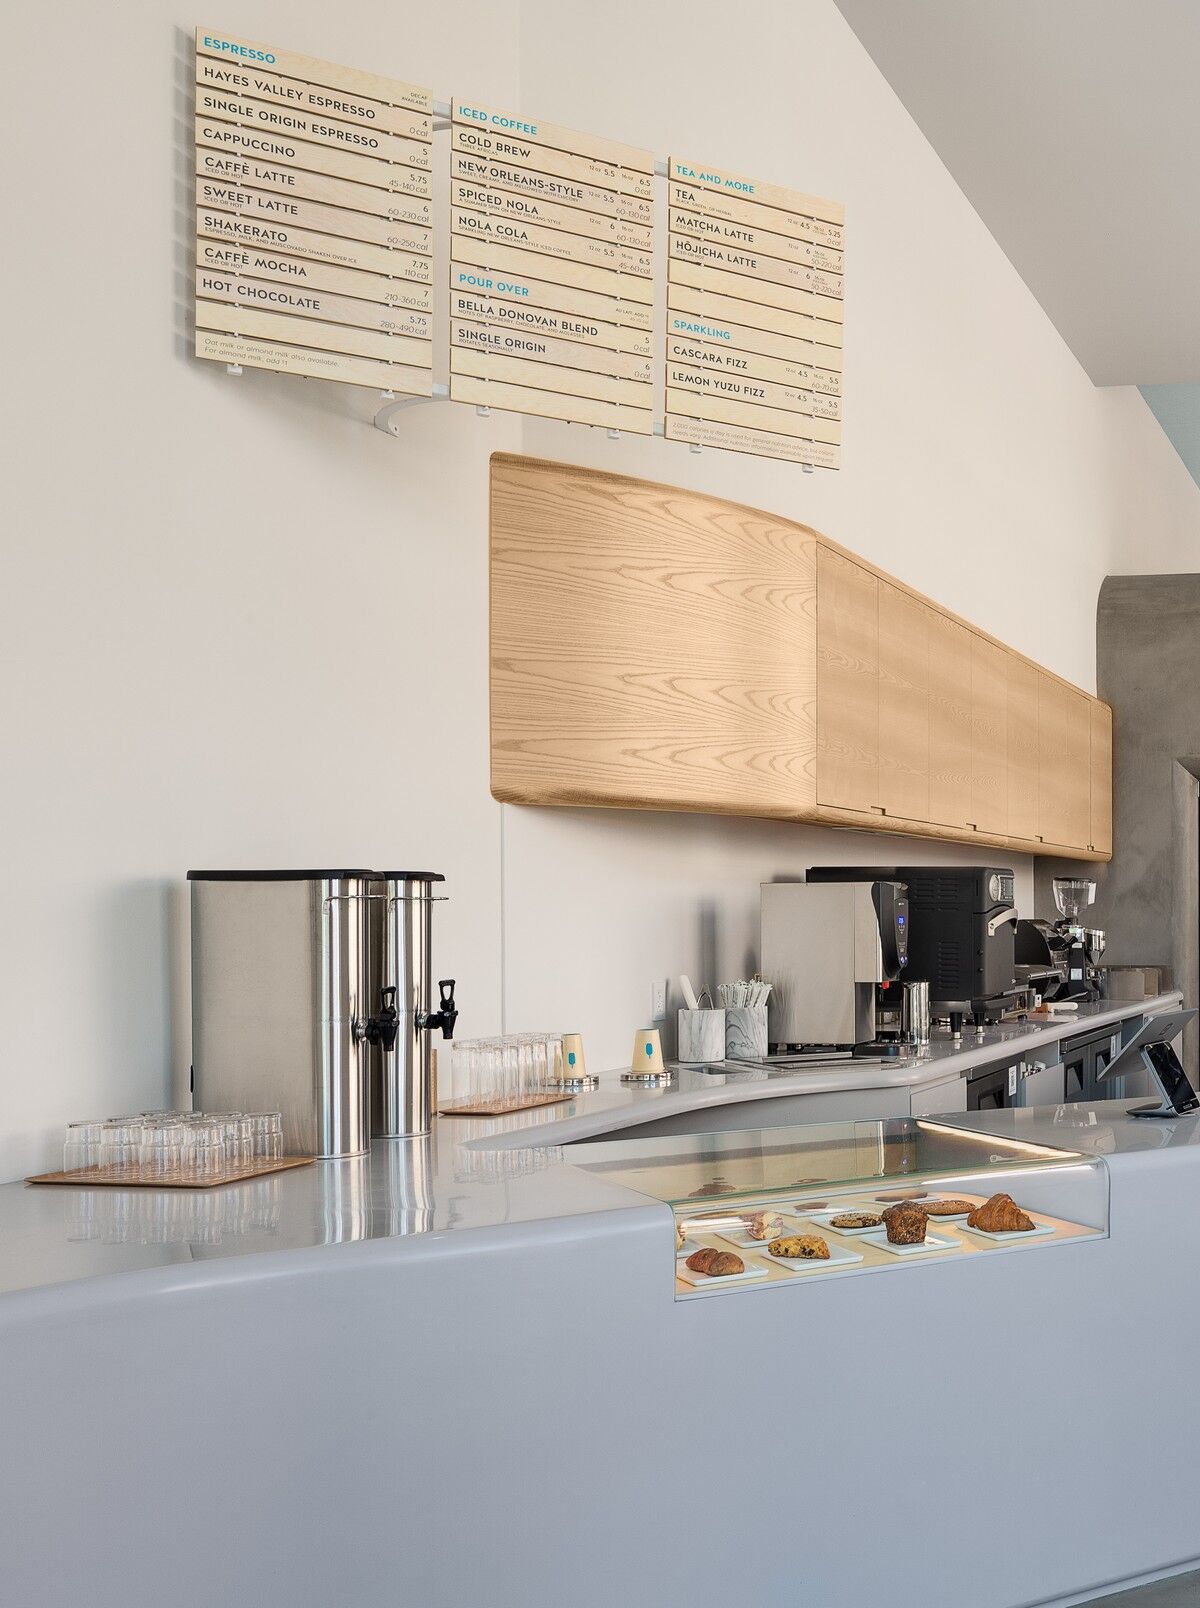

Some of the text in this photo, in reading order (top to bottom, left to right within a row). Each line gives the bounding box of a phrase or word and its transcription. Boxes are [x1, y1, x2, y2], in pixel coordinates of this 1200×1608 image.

[204, 37, 276, 64] ESPRESSO
[204, 67, 249, 87] HAYES
[254, 80, 303, 101] VALLEY
[308, 94, 376, 119] ESPRESSO
[204, 97, 254, 118] SINGLE
[258, 110, 306, 131] ORIGIN
[311, 123, 379, 149] ESPRESSO
[459, 106, 538, 135] ICED COFFEE
[203, 128, 427, 184] CAPPUCCINO 5.75
[459, 133, 492, 149] COLD
[496, 143, 531, 158] BREW
[604, 169, 615, 177] 5.5
[639, 179, 651, 187] 6.5
[205, 156, 250, 176] CAFFÈ
[255, 168, 295, 186] LATTE
[205, 166, 219, 174] ICED
[230, 172, 243, 180] HOT
[676, 165, 755, 194] TEA AND MORE
[203, 185, 253, 205] SWEET
[258, 198, 298, 216] LATTE
[458, 160, 650, 212] NEW ORLEANS-STYLE 5.5 6.5
[229, 201, 242, 209] HOT
[459, 188, 502, 206] SPICED
[506, 199, 539, 215] NOLA
[676, 189, 695, 201] TEA
[800, 222, 810, 230] 4.5
[204, 216, 429, 270] SHAKERATO 7.75
[459, 216, 651, 266] NOLA COLA 5.5 6.5
[676, 216, 720, 234] MATCHA
[725, 228, 754, 243] LATTE
[205, 248, 249, 265] CAFFÈ
[255, 258, 307, 277] MOCHA
[270, 241, 307, 253] MUSCOVADO
[308, 249, 331, 258] SHAKEN
[727, 254, 757, 269] LATTE
[459, 273, 529, 296] POUR OVER
[203, 278, 427, 326] HOT CHOCOLATE 5.75
[458, 299, 494, 315] BELLA
[499, 308, 557, 327] DONOVAN
[562, 321, 598, 336] BLEND
[674, 319, 731, 340] SPARKLING
[204, 338, 218, 346] Oat
[246, 346, 273, 356] almond
[275, 351, 288, 359] milk
[219, 350, 246, 359] almond
[458, 328, 500, 345] SINGLE
[505, 337, 546, 353] ORIGIN
[673, 346, 722, 364] CASCARA
[726, 357, 748, 369] FIZZ
[798, 370, 808, 378] 4.5
[672, 371, 710, 386] LEMON
[714, 380, 740, 393] YUZU
[743, 386, 765, 398] FIZZ
[797, 394, 807, 402] 4.5
